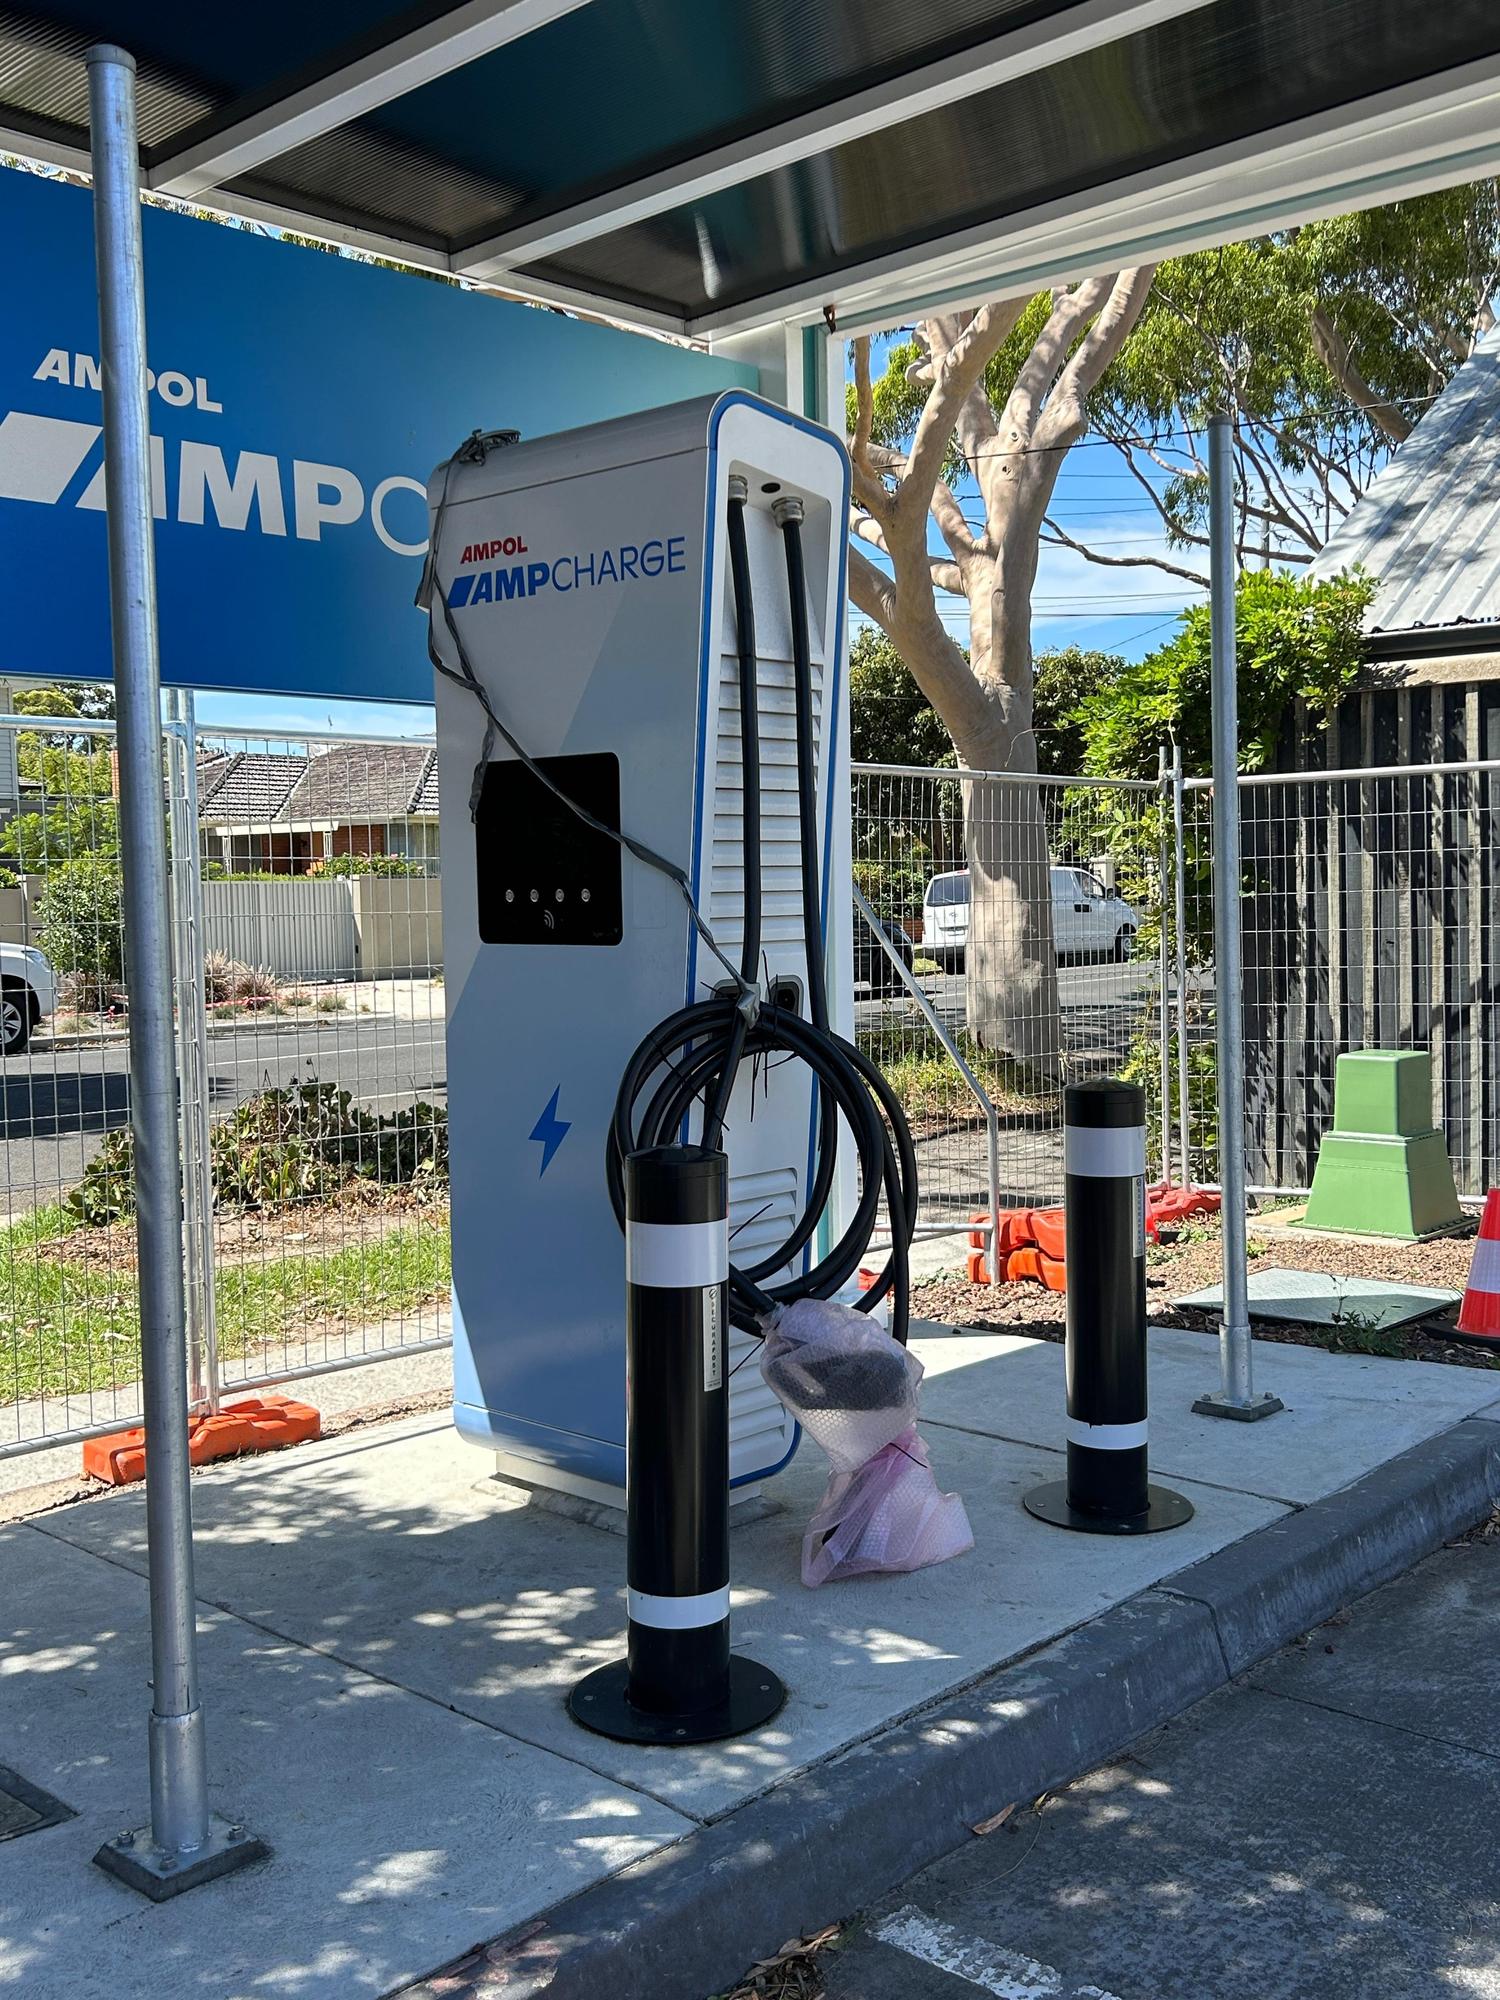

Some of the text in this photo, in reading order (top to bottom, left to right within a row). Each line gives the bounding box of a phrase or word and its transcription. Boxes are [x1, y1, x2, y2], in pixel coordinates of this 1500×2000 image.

[33, 348, 223, 413] AMOL
[460, 536, 528, 564] AMPOL
[470, 536, 686, 605] AMPCHARGE
